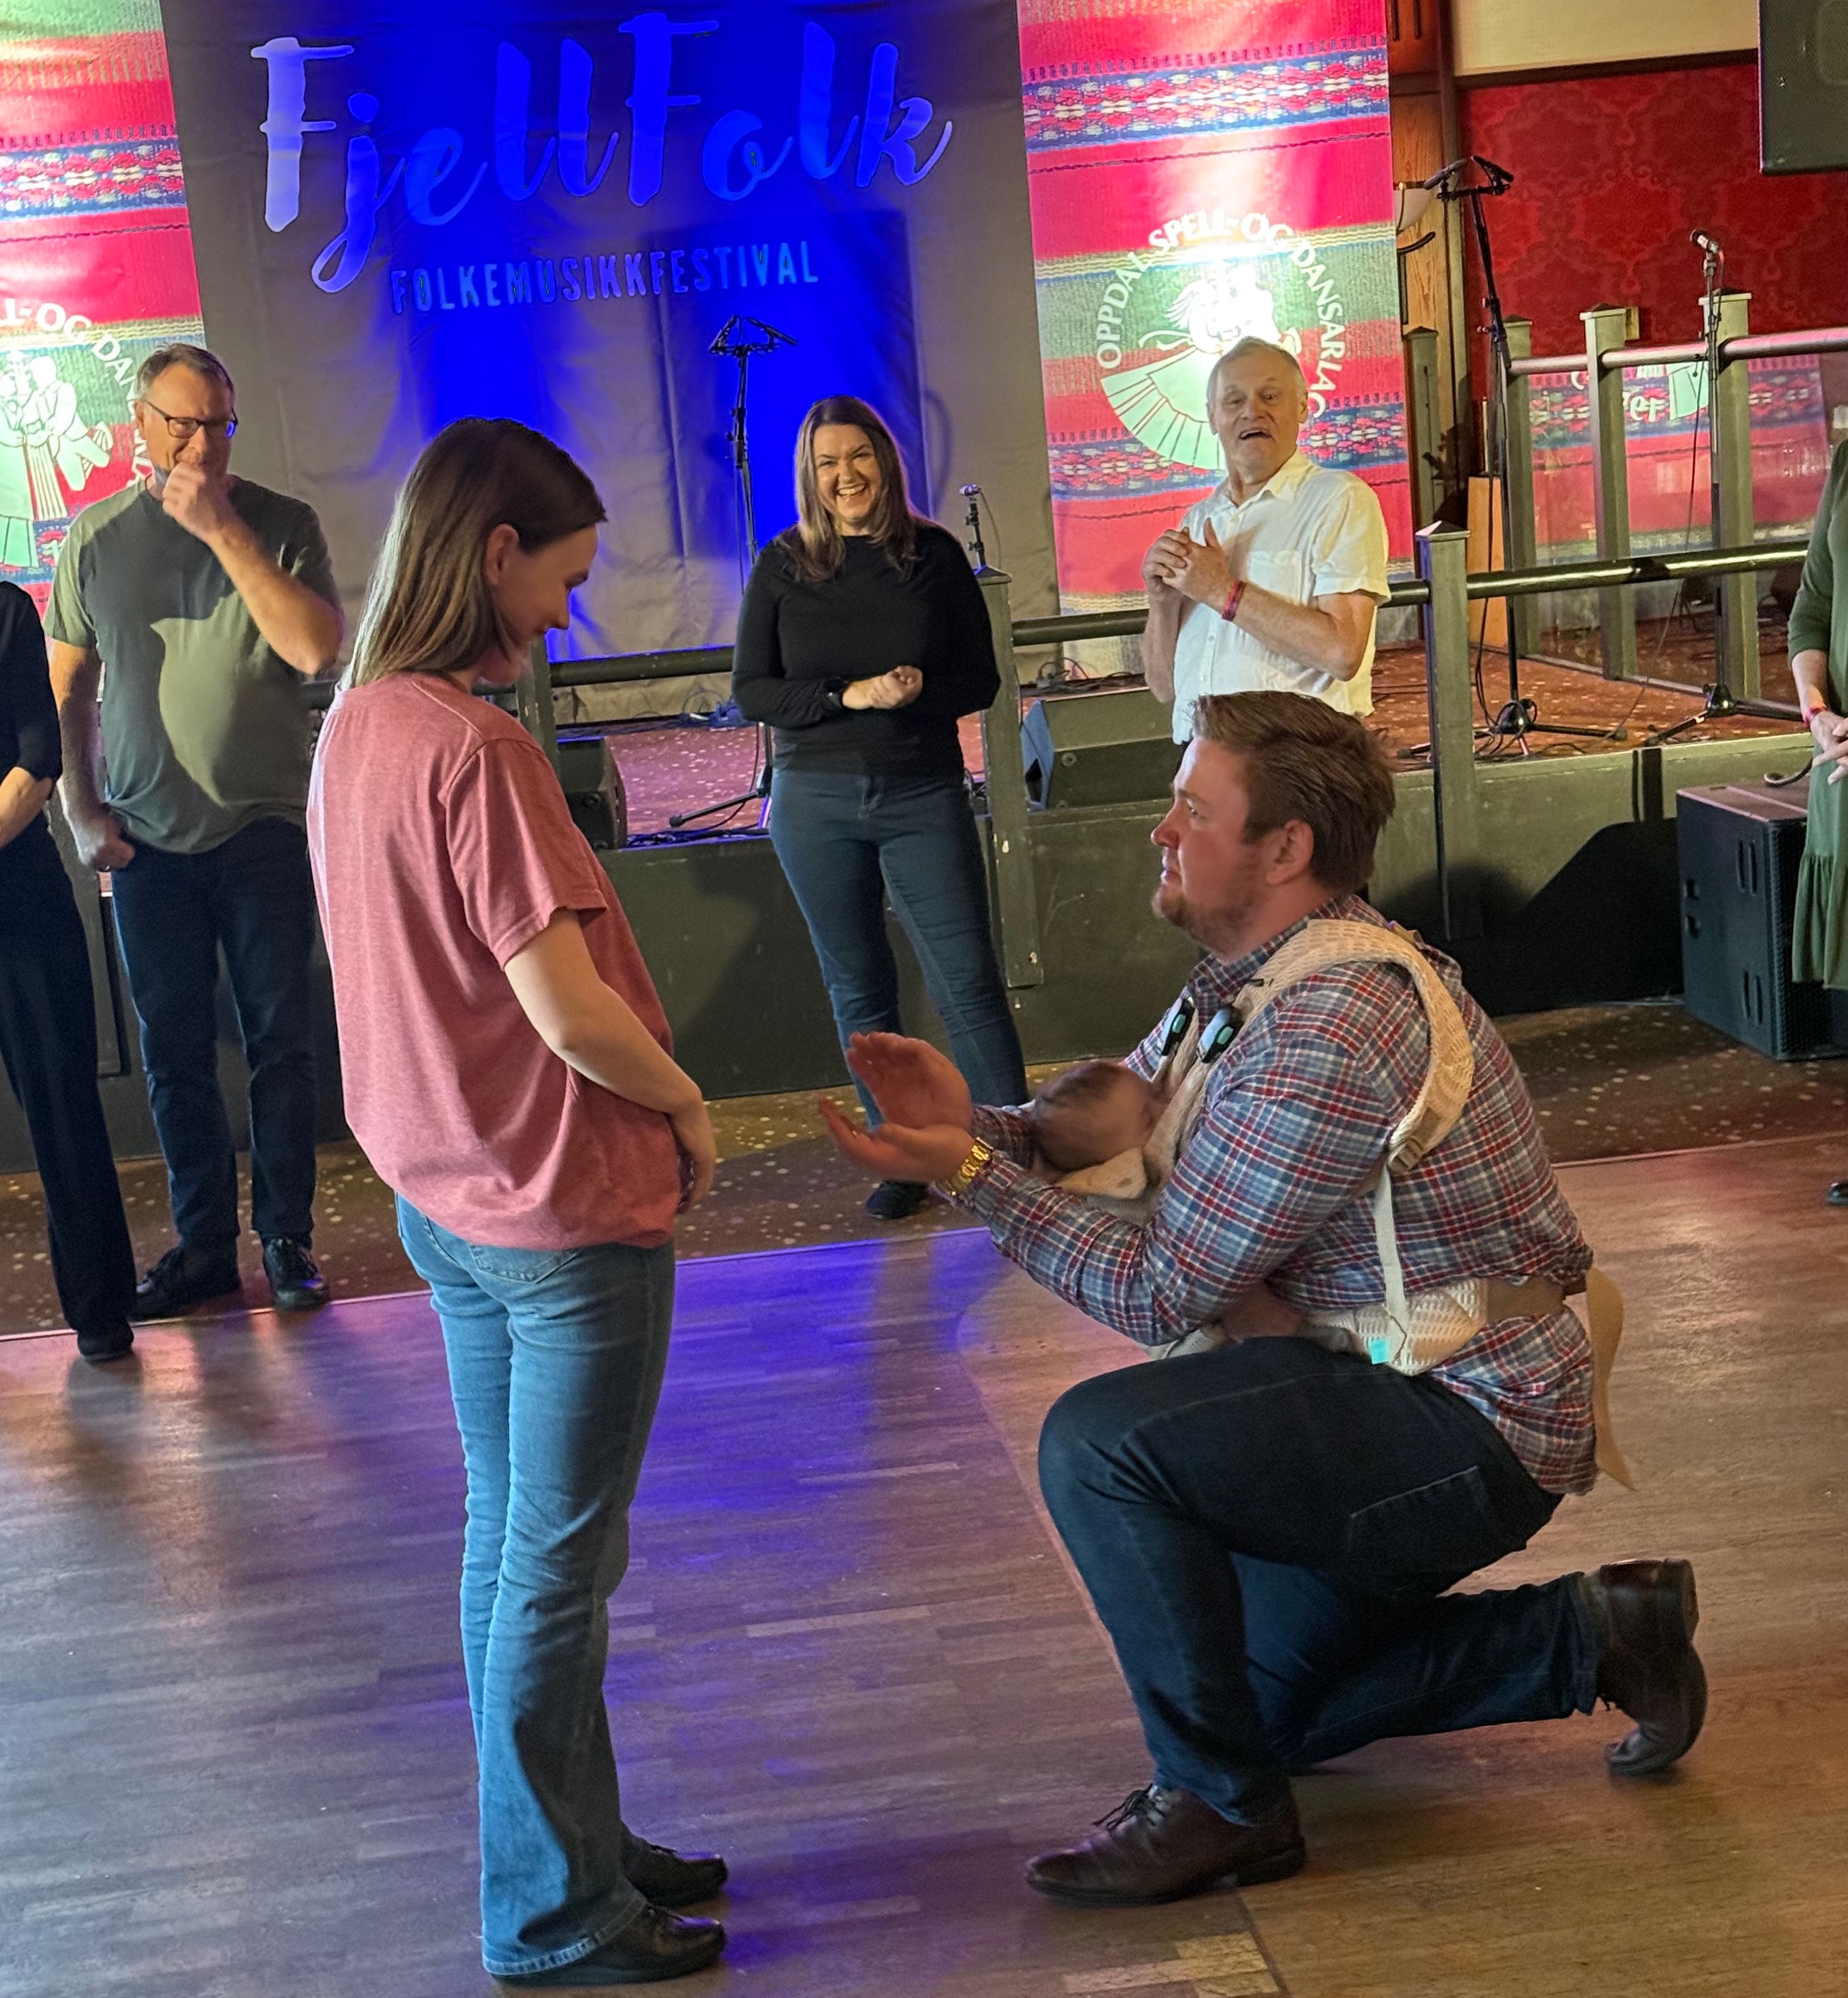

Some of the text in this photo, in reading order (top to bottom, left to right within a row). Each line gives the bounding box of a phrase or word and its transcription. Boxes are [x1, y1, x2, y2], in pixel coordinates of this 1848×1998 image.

[251, 12, 952, 293] FjellFolk
[391, 241, 818, 314] FOLKEMUSIKKFESTIVAL
[1096, 251, 1154, 369] OPPDAL
